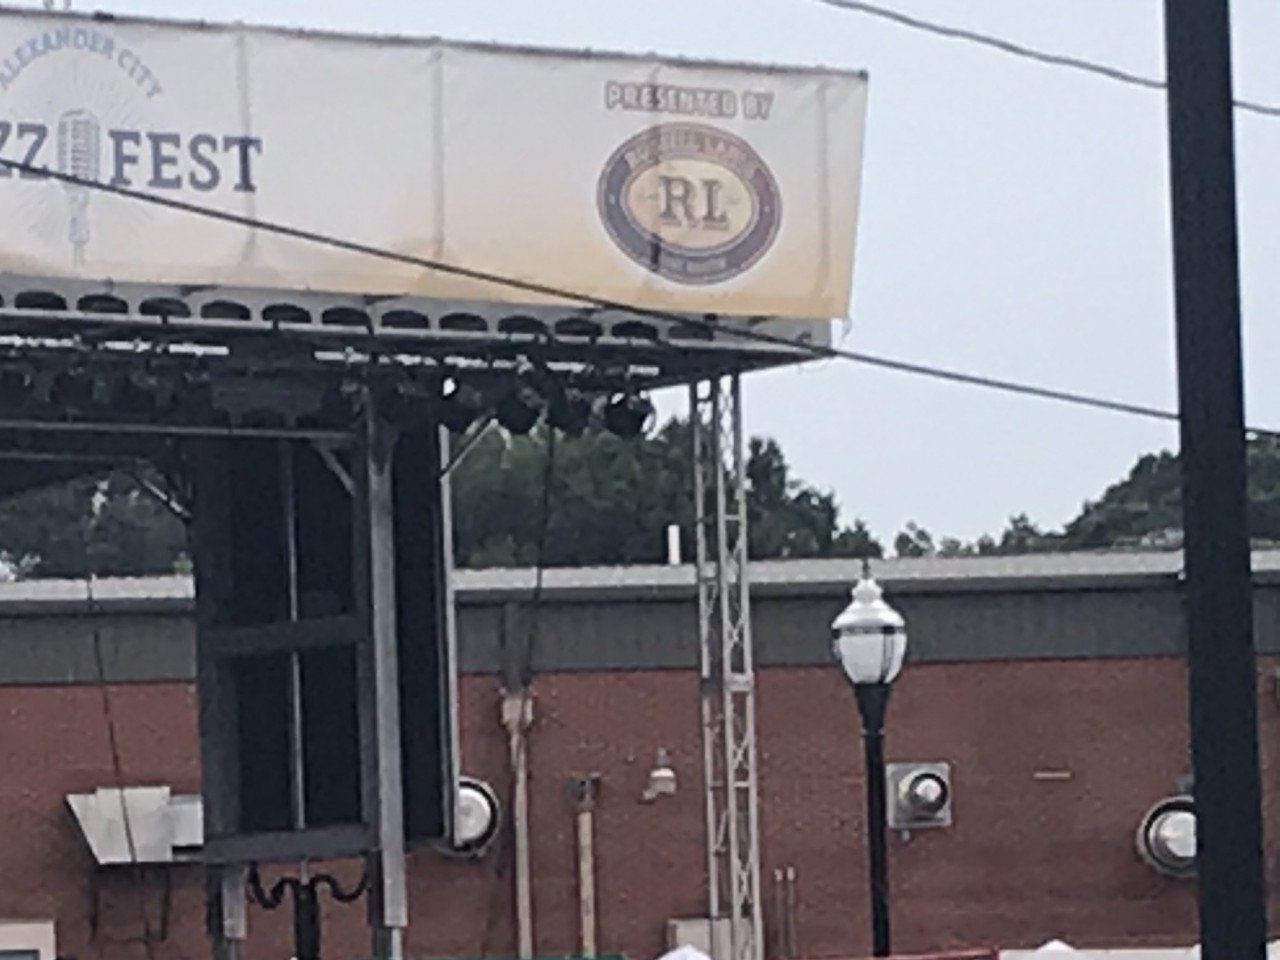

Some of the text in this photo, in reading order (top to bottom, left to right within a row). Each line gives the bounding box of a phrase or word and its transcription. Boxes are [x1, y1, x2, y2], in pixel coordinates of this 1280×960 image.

[117, 48, 163, 99] CITY
[604, 80, 738, 119] PRESENTED
[108, 130, 263, 193] FEST
[658, 175, 730, 230] RL
